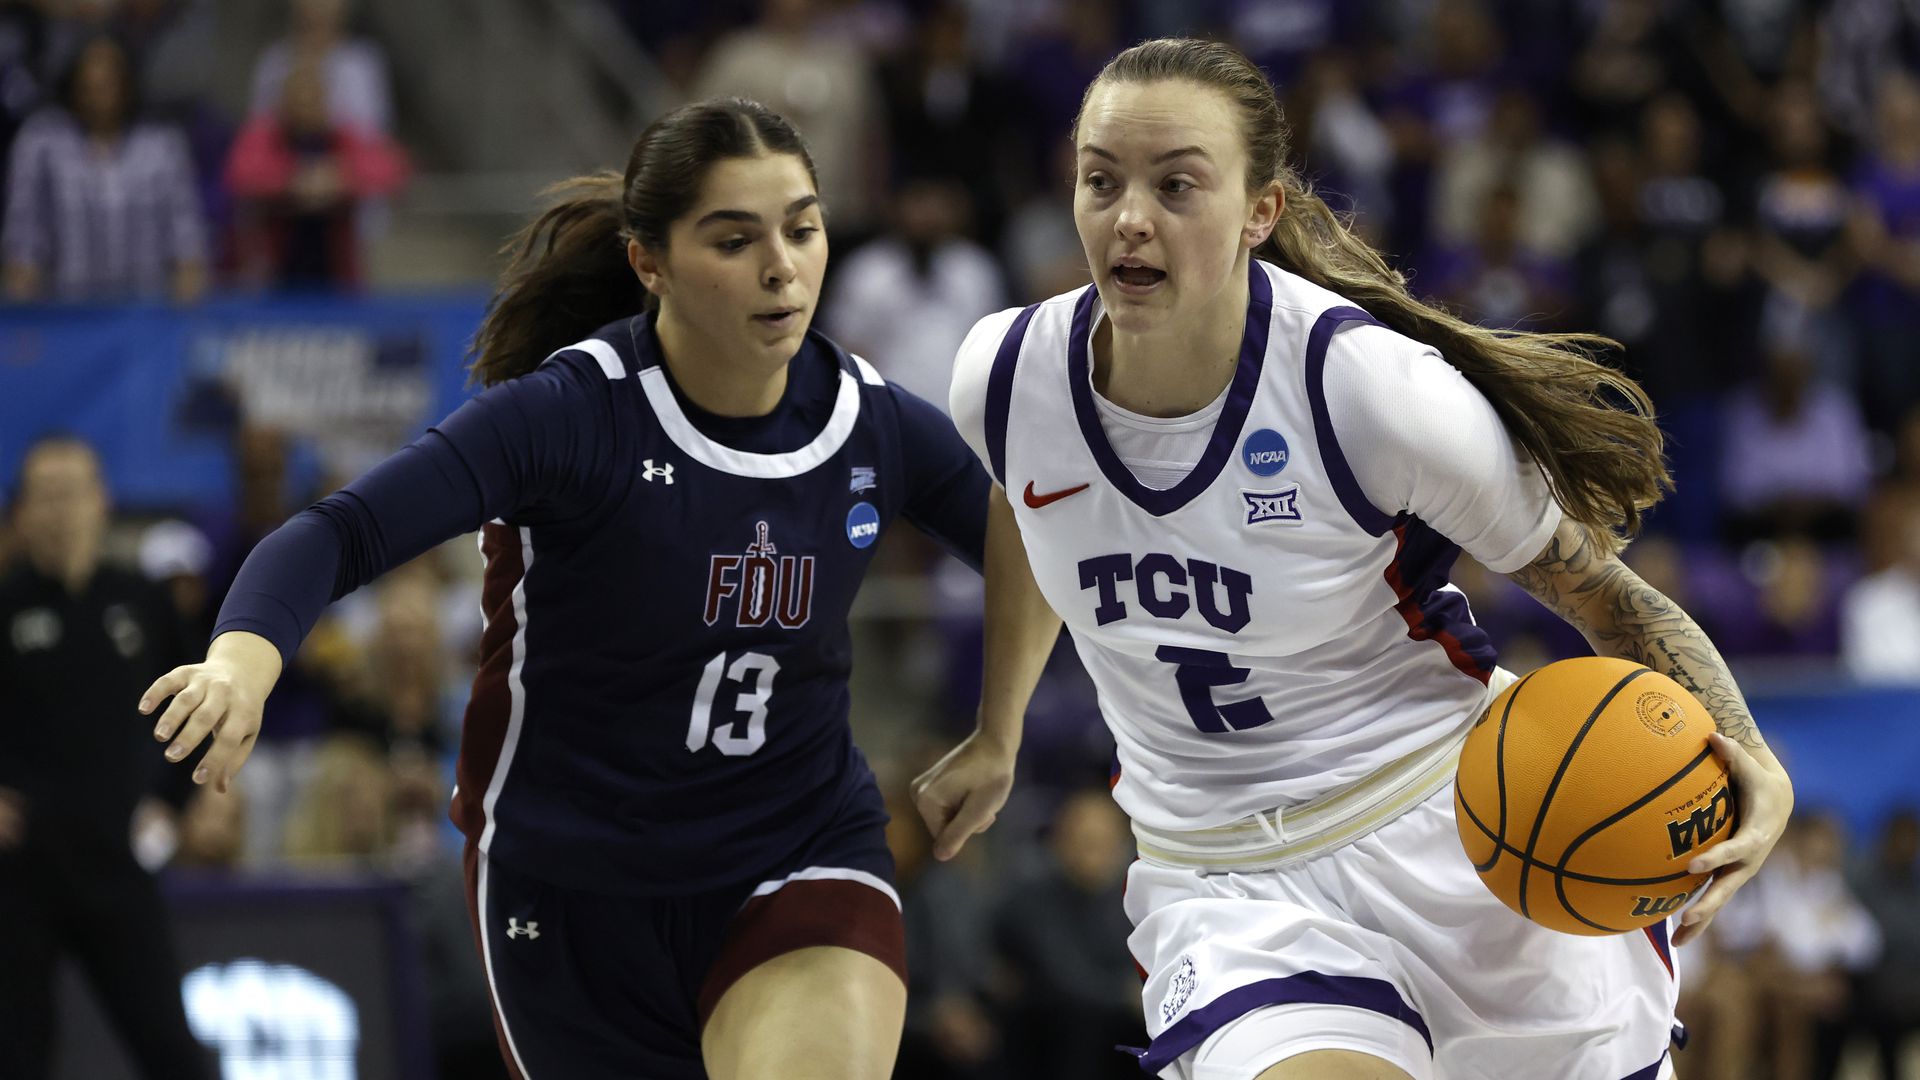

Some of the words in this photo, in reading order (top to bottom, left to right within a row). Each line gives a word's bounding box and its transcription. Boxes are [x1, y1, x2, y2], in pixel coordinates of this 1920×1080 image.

[1250, 450, 1286, 465] NCAA
[703, 554, 815, 629] FDU
[1077, 552, 1253, 634] TCU
[686, 651, 781, 756] 13
[1665, 800, 1693, 816] BALL
[1666, 786, 1734, 859] CAA
